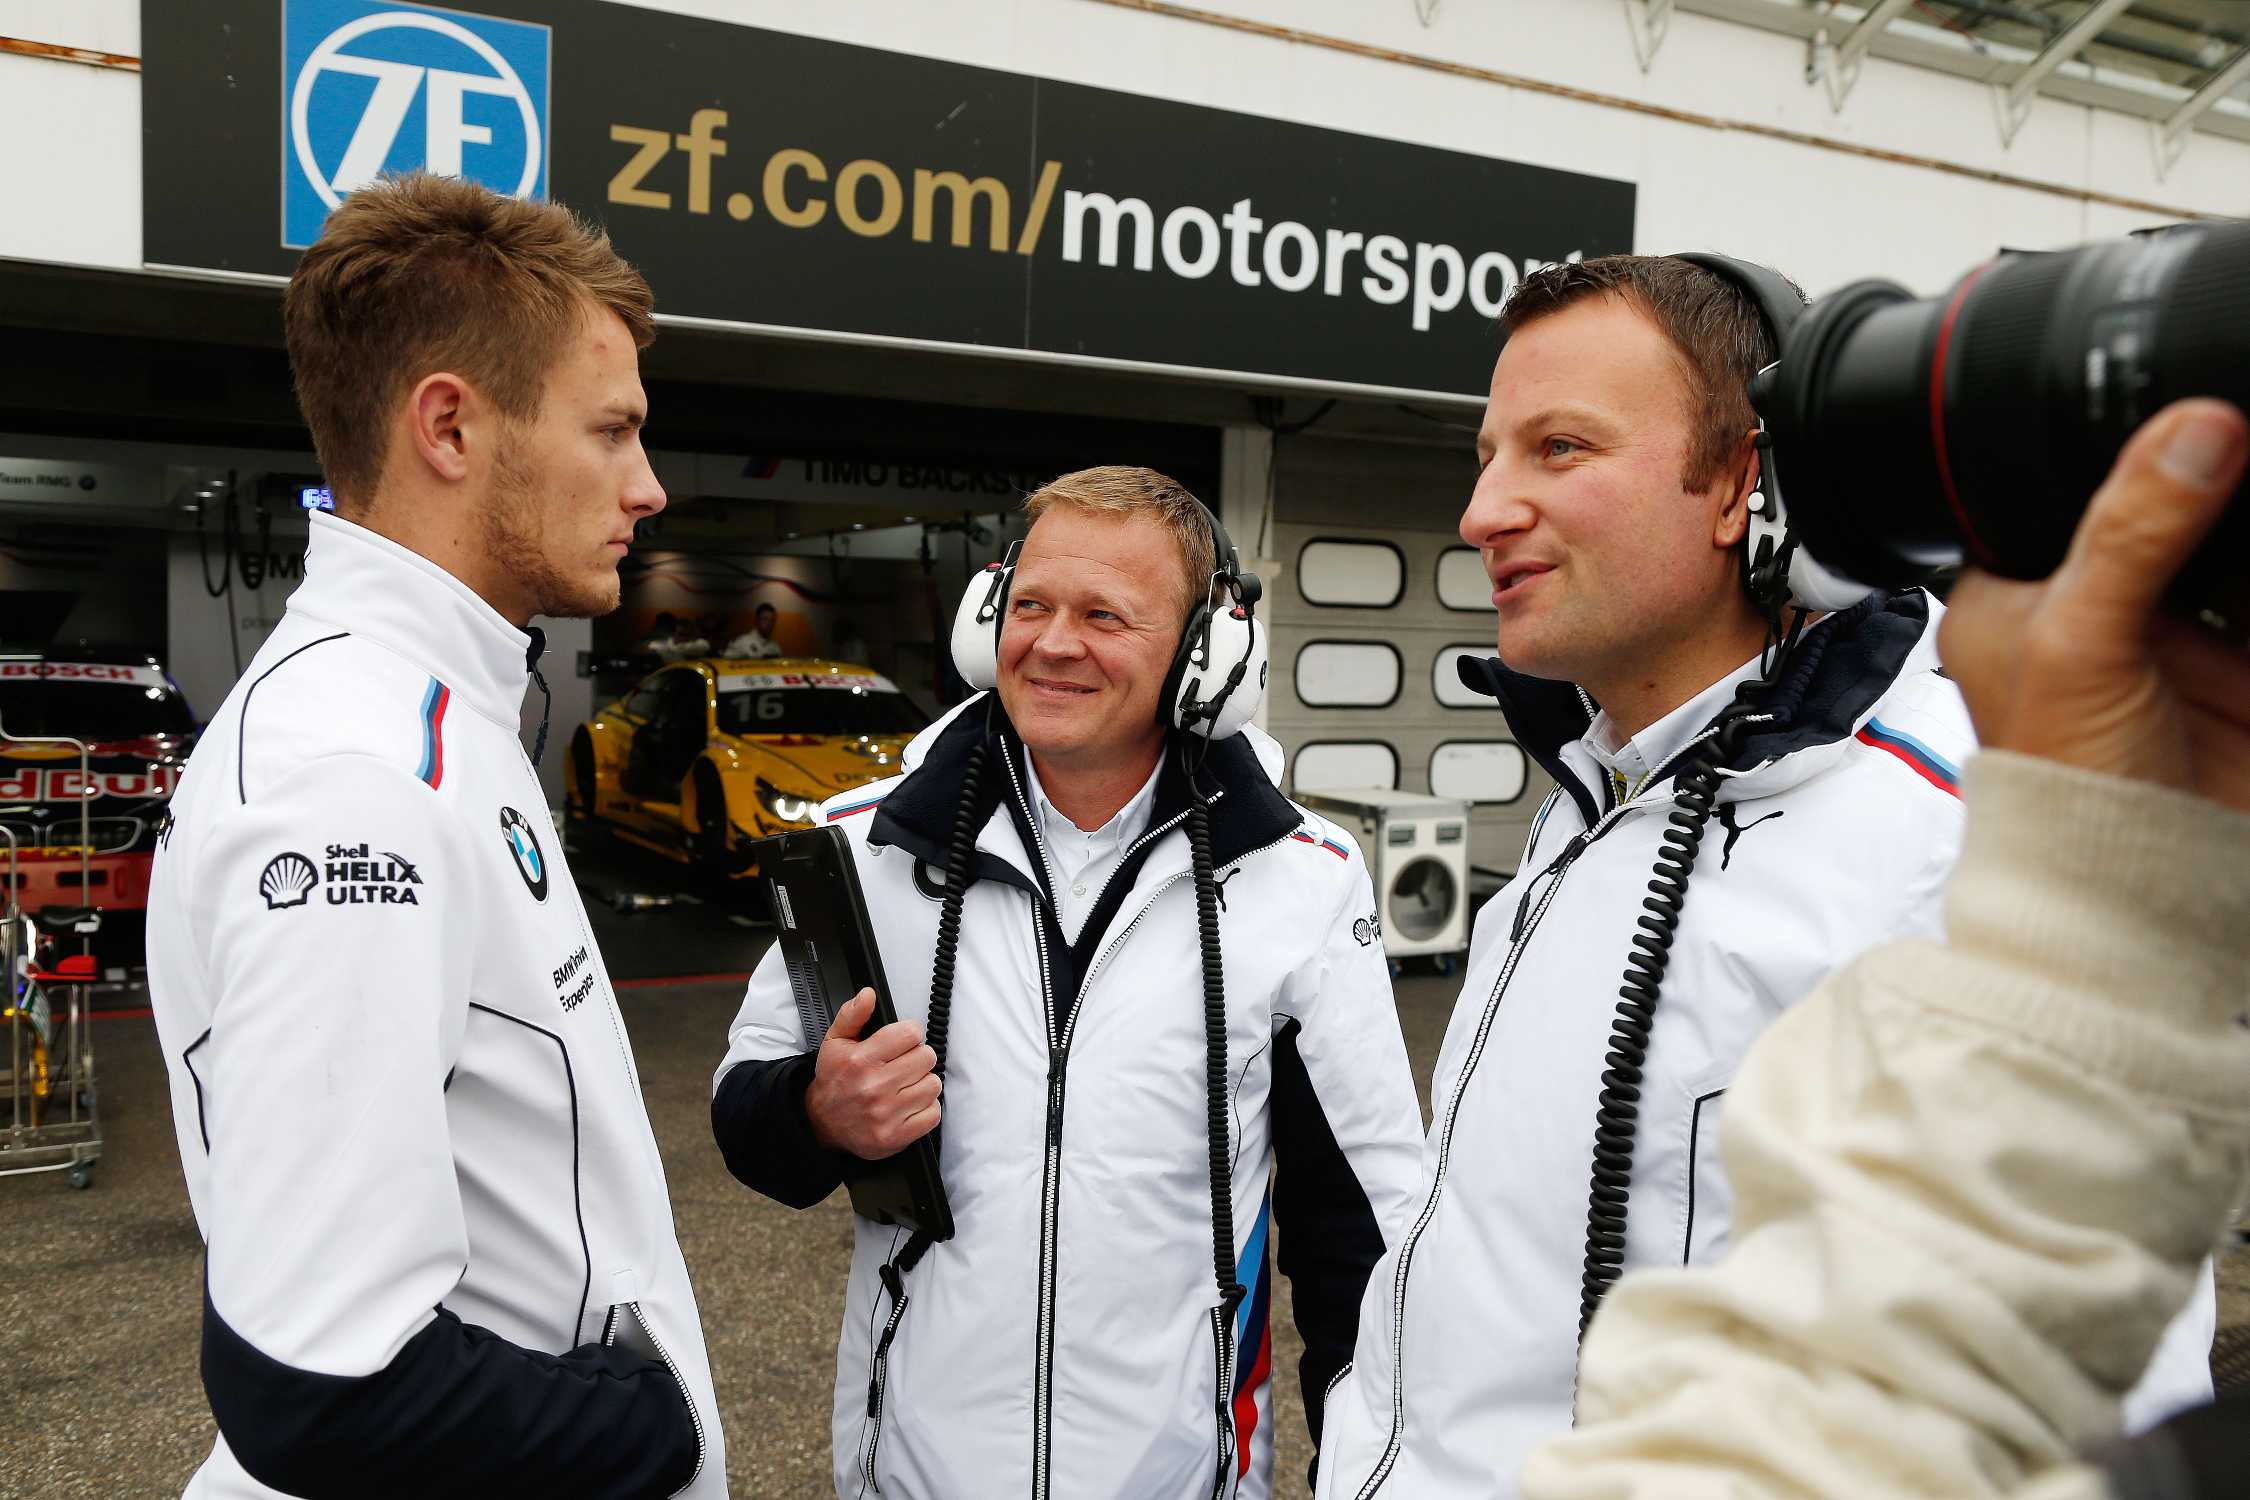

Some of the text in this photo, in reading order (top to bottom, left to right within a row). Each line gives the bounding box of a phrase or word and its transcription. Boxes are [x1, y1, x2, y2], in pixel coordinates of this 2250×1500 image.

[318, 52, 518, 194] ZF
[606, 107, 1584, 332] zf.com/motorspo
[802, 456, 1045, 497] TIMO BACKST
[243, 553, 304, 579] BM
[2, 664, 135, 680] BOSCH
[731, 693, 785, 721] 16
[325, 843, 369, 860] Shell
[324, 860, 424, 885] HELIX
[326, 885, 420, 906] ULTRA
